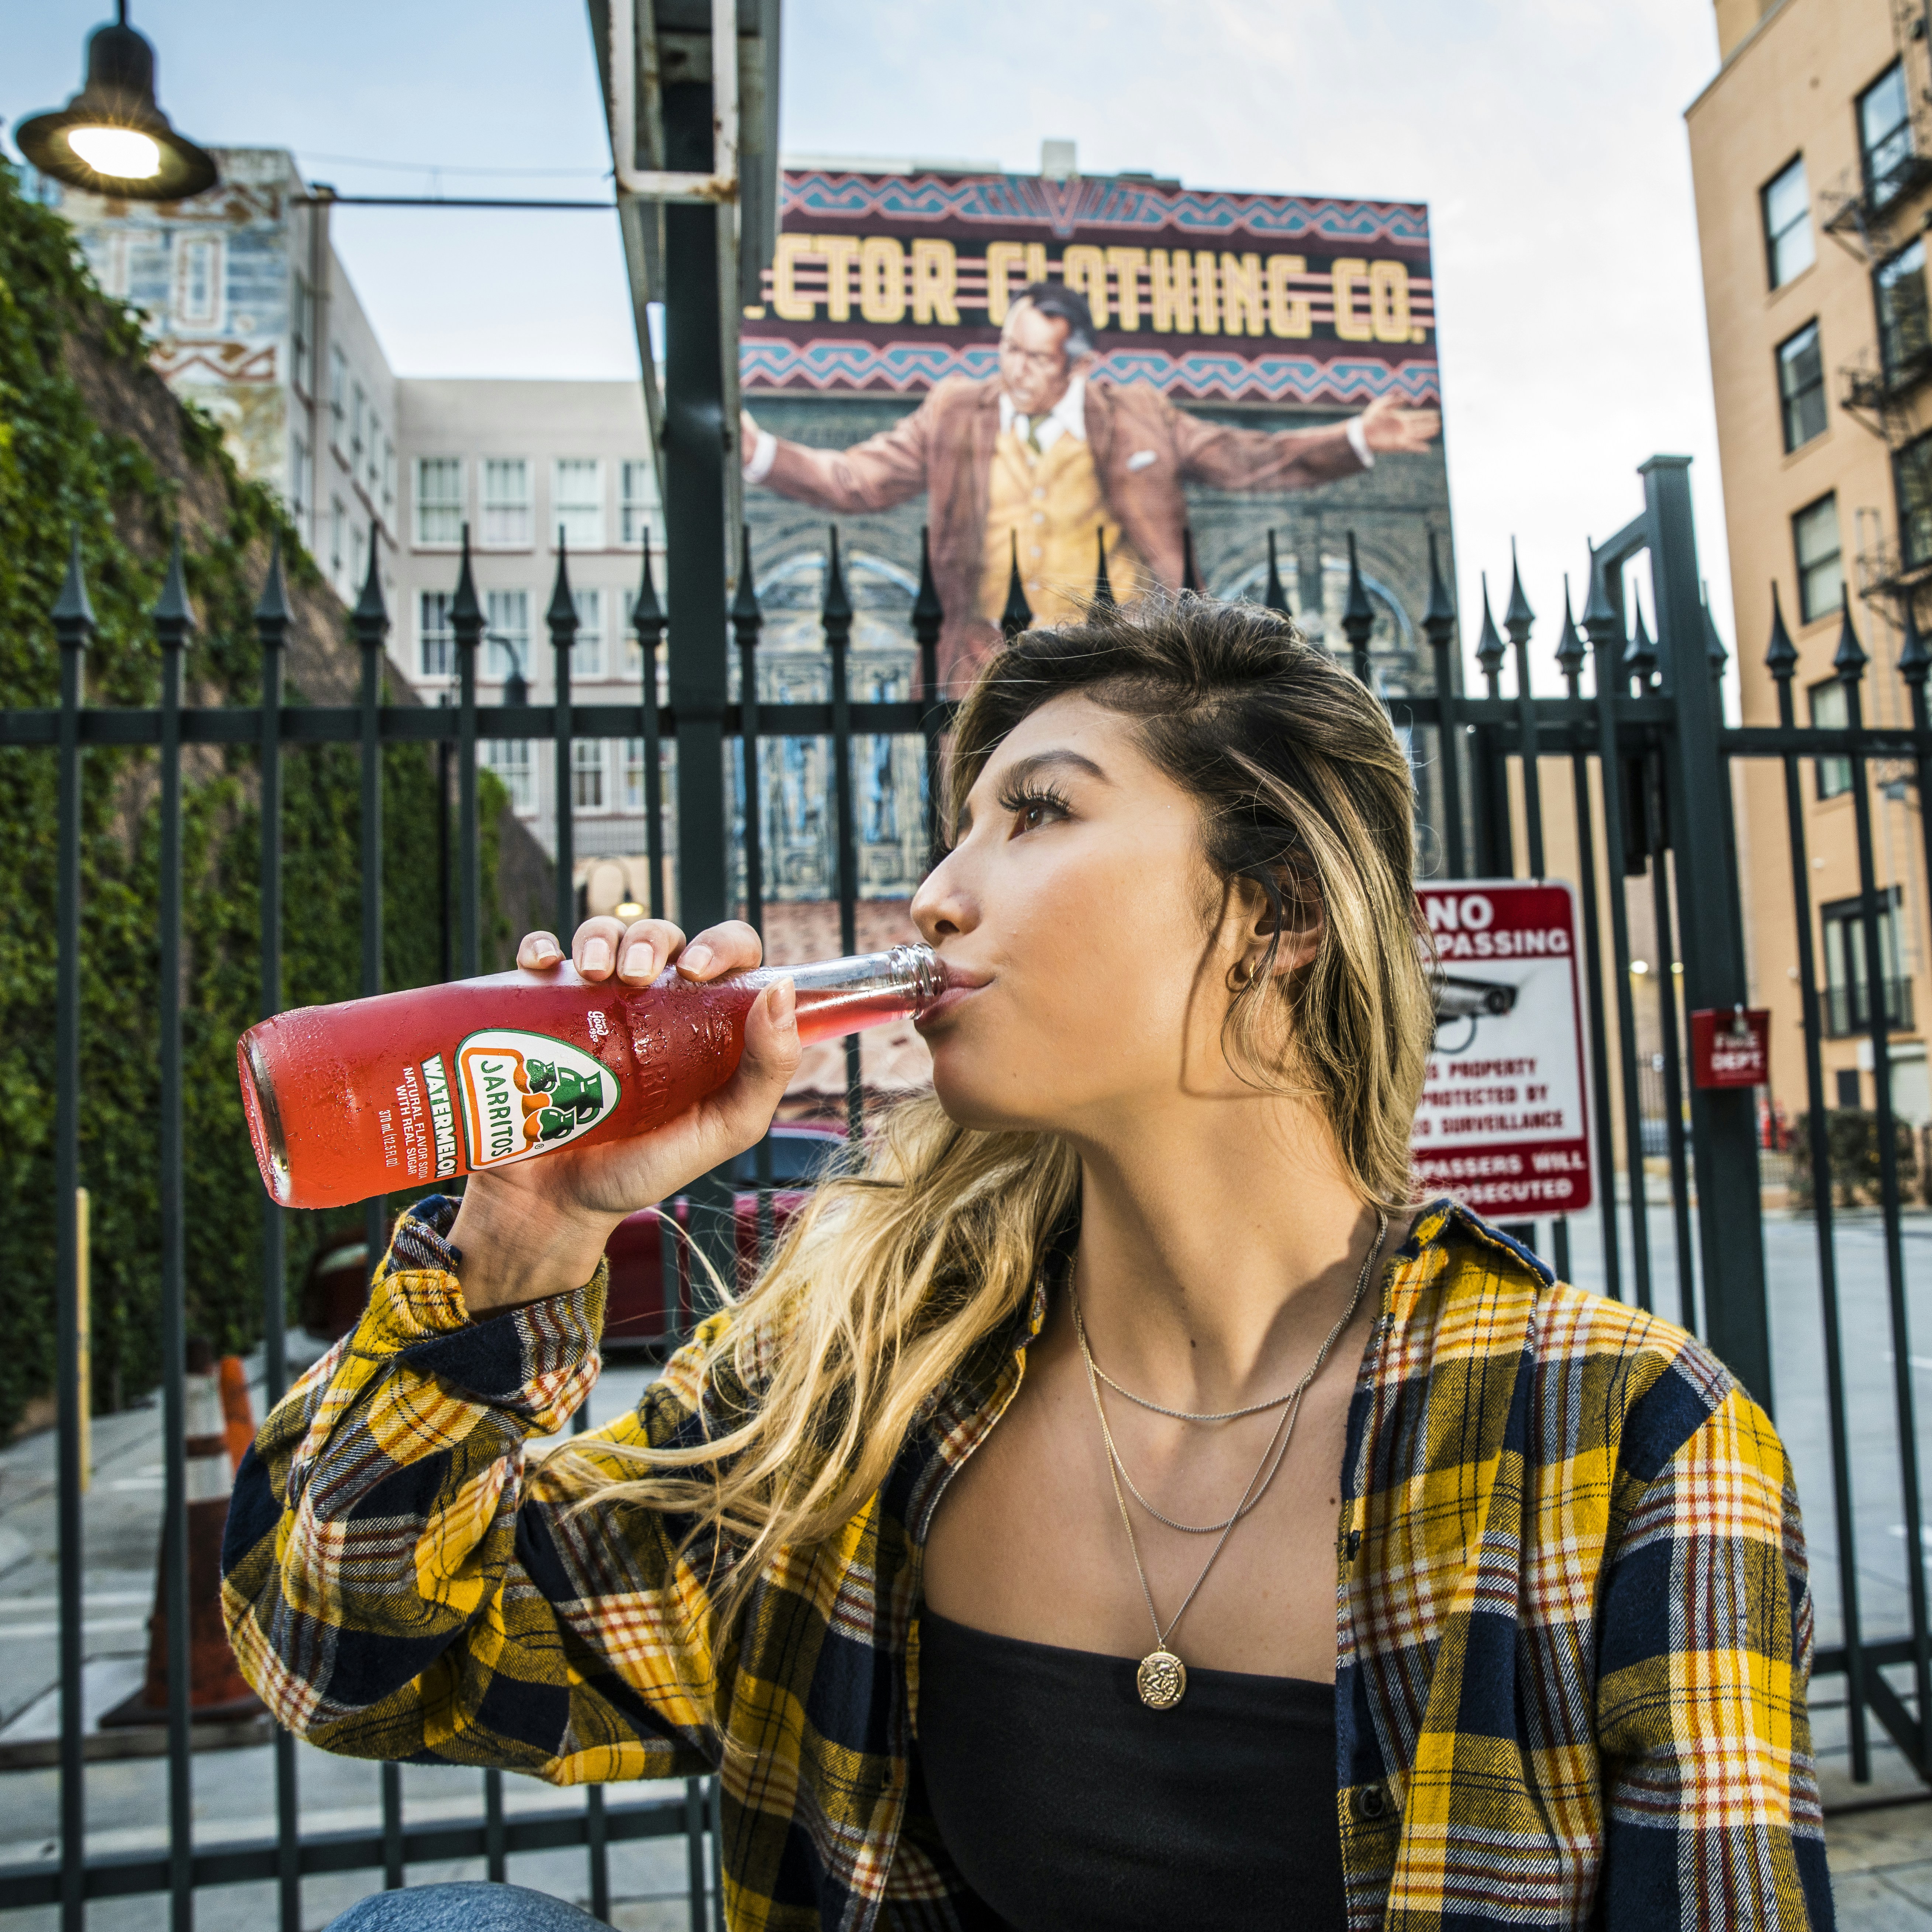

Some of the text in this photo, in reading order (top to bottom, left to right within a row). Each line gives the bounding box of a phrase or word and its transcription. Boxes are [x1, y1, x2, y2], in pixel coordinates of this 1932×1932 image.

[742, 232, 960, 325] CTOR
[1331, 257, 1426, 344] CO.
[1425, 893, 1495, 931] NO
[588, 1011, 609, 1036] Good
[589, 1028, 598, 1042] 1950
[1449, 1058, 1536, 1078] PROPERTY
[1421, 1084, 1548, 1107] PROTECTED BY
[379, 1110, 391, 1123] 370
[421, 1053, 457, 1178] WATERMELON
[480, 1060, 514, 1157] JARRITOS
[381, 1123, 394, 1135] mL
[396, 1084, 417, 1176] WITH REAL SUGAR
[403, 1067, 427, 1179] NATURAL FLAVOR SODA
[1442, 1109, 1563, 1135] SURVEILLANCE
[383, 1134, 397, 1150] (12.5
[386, 1159, 400, 1167] OZ)
[1531, 1149, 1586, 1174] WILL
